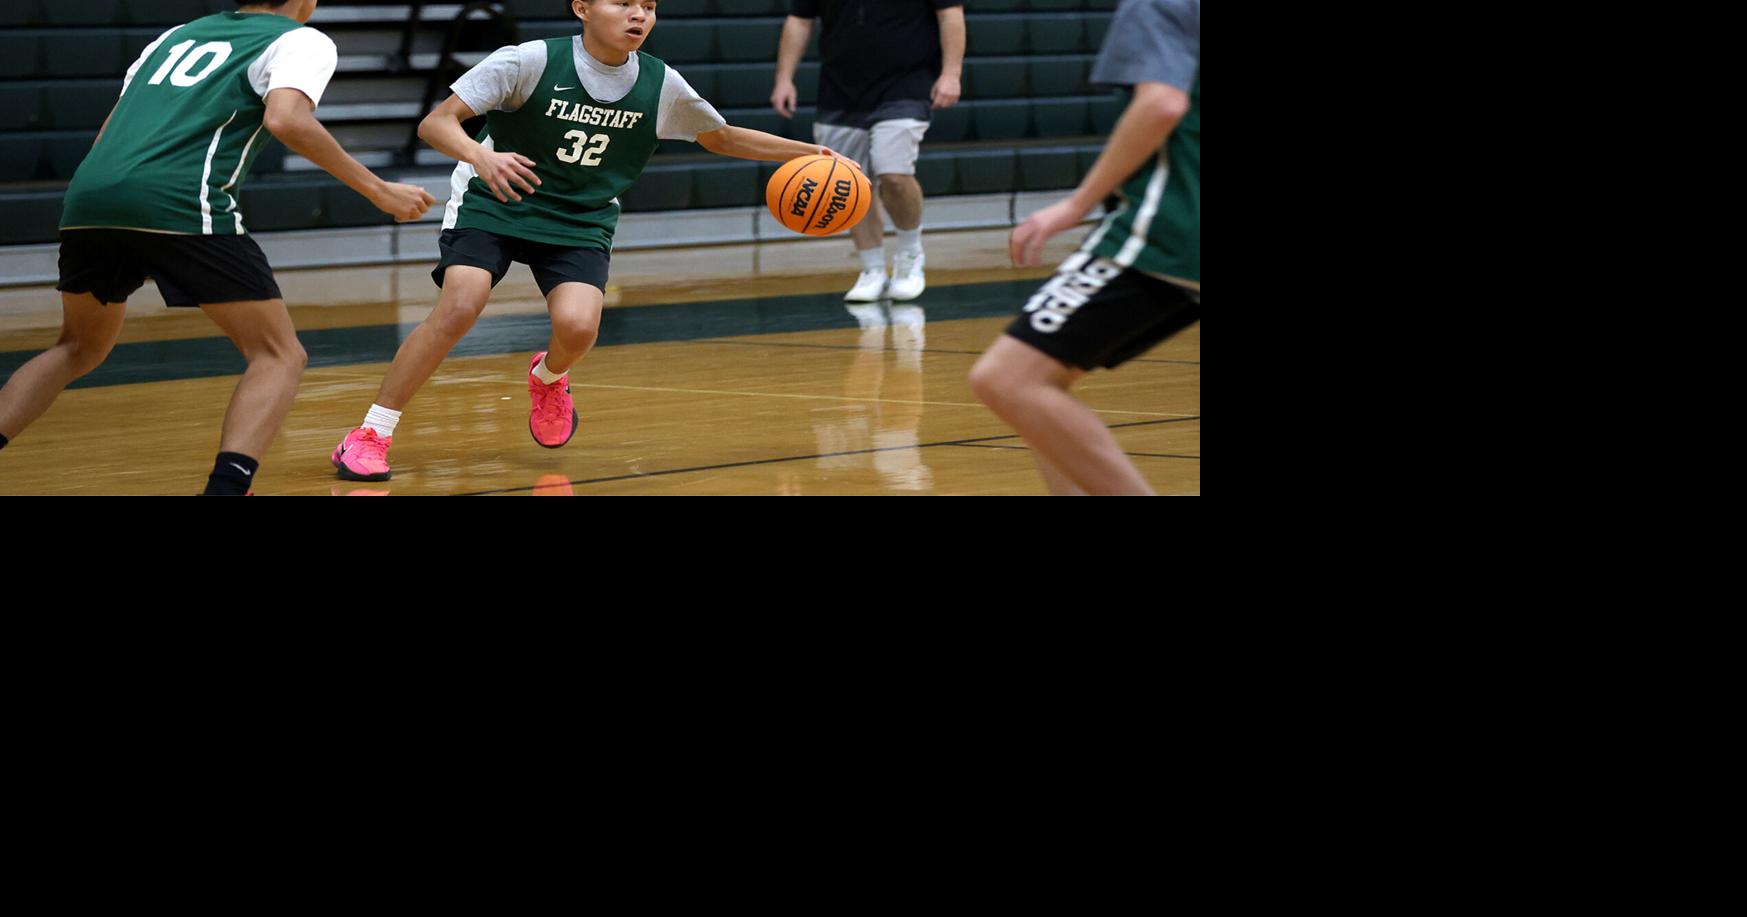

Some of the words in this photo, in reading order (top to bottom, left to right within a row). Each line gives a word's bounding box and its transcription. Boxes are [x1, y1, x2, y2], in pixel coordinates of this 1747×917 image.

[147, 39, 232, 87] 10
[545, 98, 644, 129] FLAGSTAFF
[556, 129, 611, 167] 32
[790, 178, 819, 217] NCAA
[814, 180, 852, 229] Wilson
